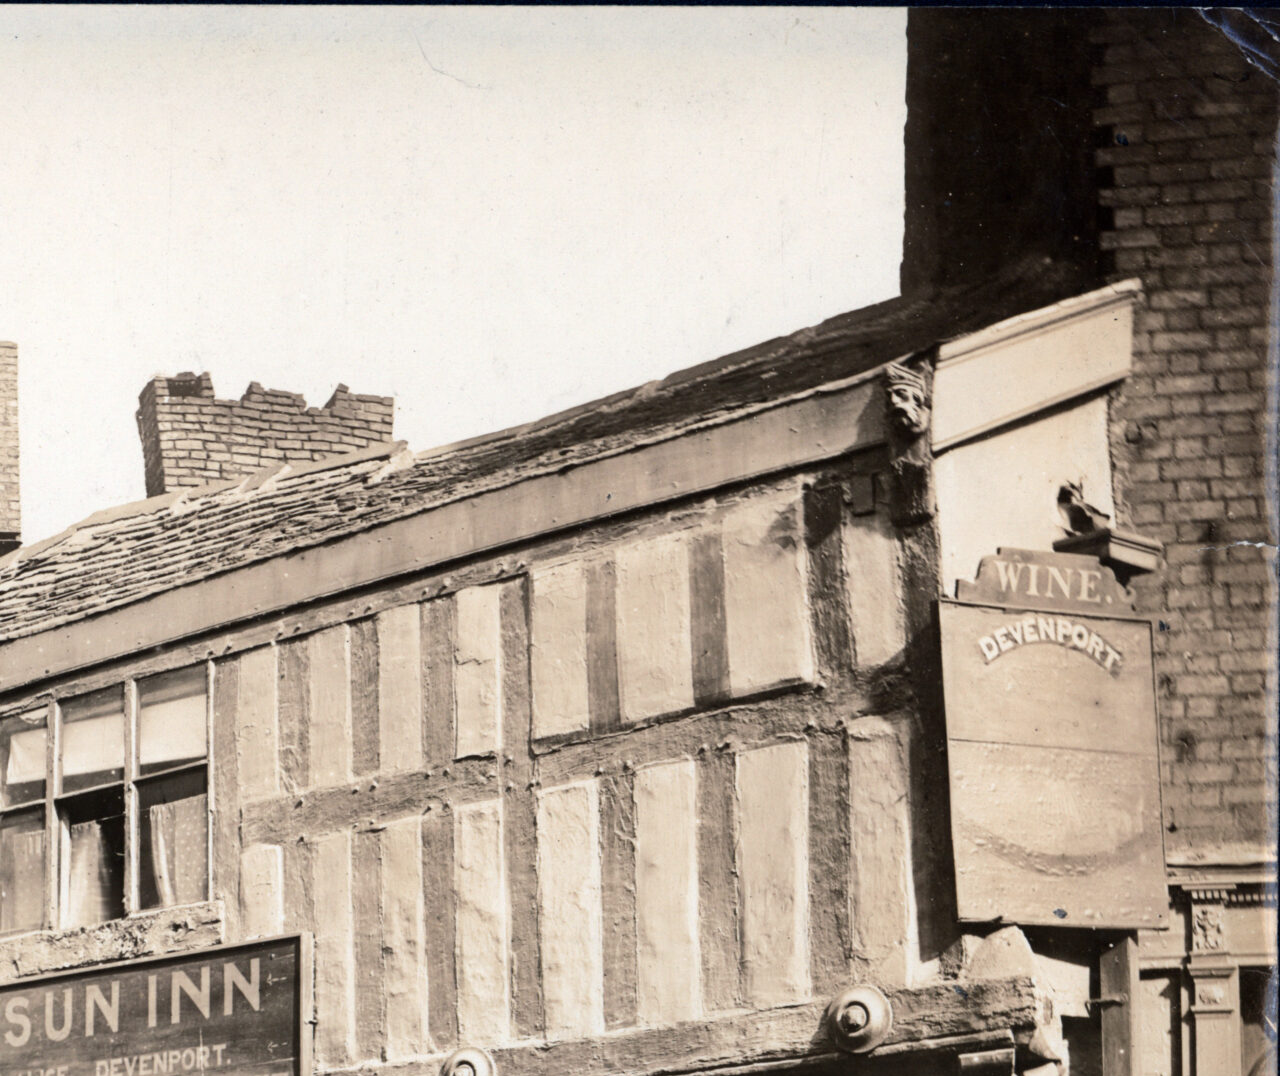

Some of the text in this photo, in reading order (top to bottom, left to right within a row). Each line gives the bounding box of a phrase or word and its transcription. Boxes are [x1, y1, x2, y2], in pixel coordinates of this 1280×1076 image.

[978, 616, 1122, 671] DEVENPORT
[4, 957, 261, 1048] SUN INN
